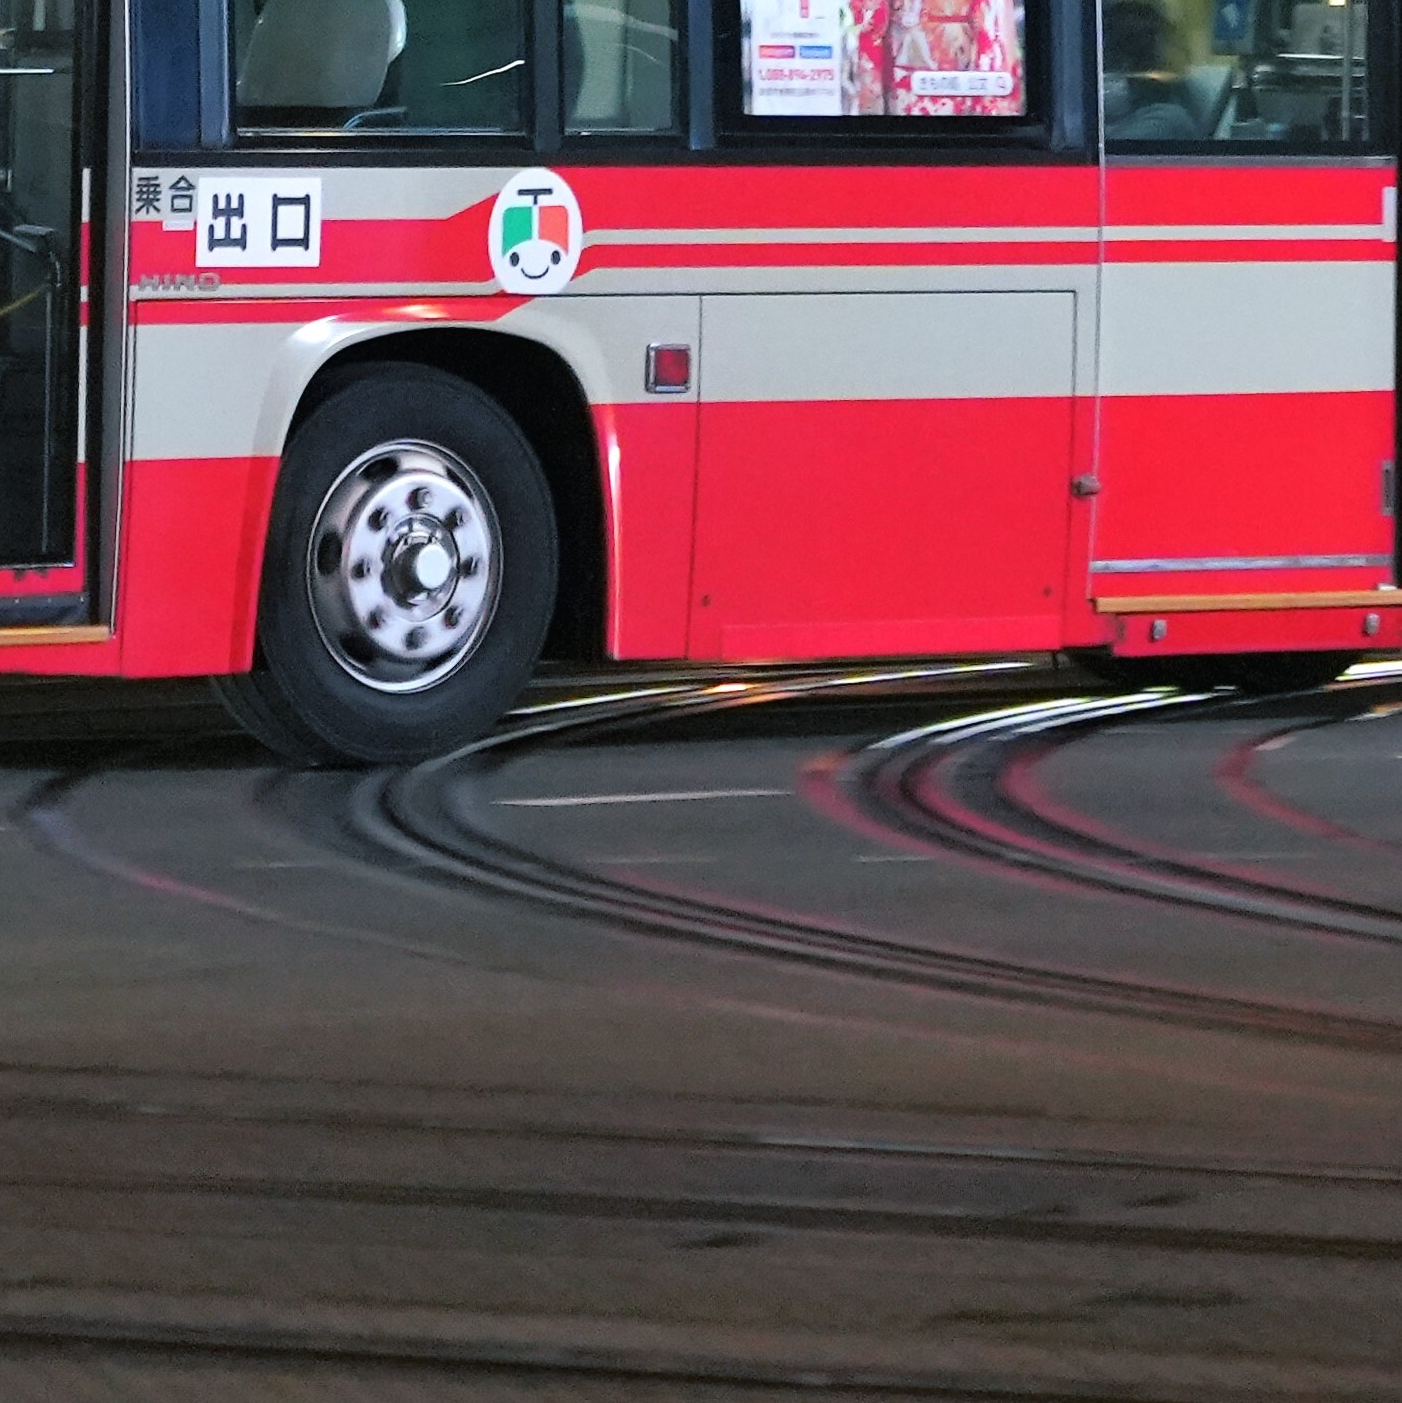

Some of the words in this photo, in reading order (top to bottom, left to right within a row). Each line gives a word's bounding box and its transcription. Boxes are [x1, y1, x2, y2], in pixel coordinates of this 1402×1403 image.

[135, 175, 196, 215] 乗合
[208, 193, 311, 252] 出口
[138, 272, 222, 292] HINO
